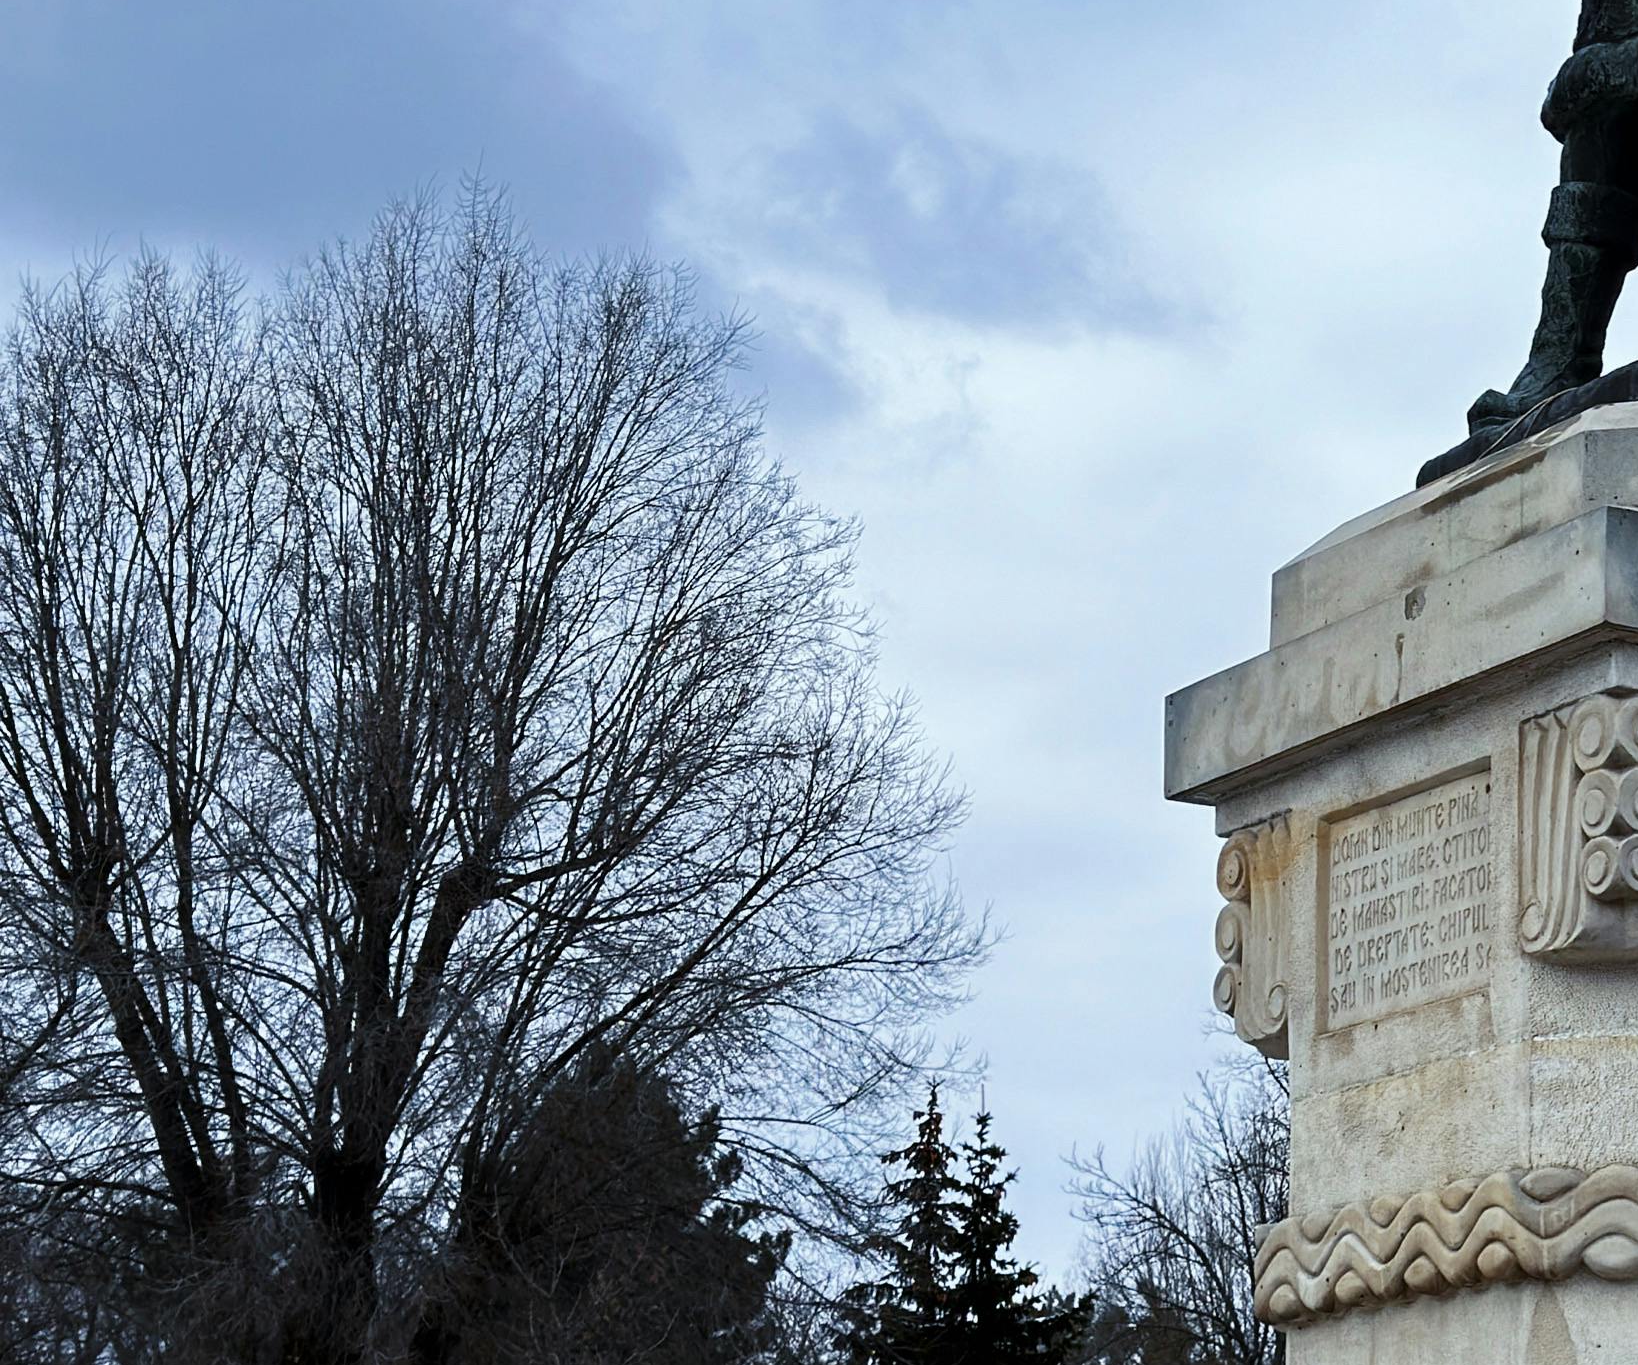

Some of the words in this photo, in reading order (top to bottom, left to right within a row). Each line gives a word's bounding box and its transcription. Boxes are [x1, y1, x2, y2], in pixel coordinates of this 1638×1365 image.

[1372, 816, 1393, 851] DIN
[1396, 802, 1444, 844] MUNTE
[1331, 861, 1377, 904] NISTRU
[1331, 907, 1347, 940] DE
[1335, 944, 1352, 975] DE
[1439, 903, 1489, 943] CHIPUL
